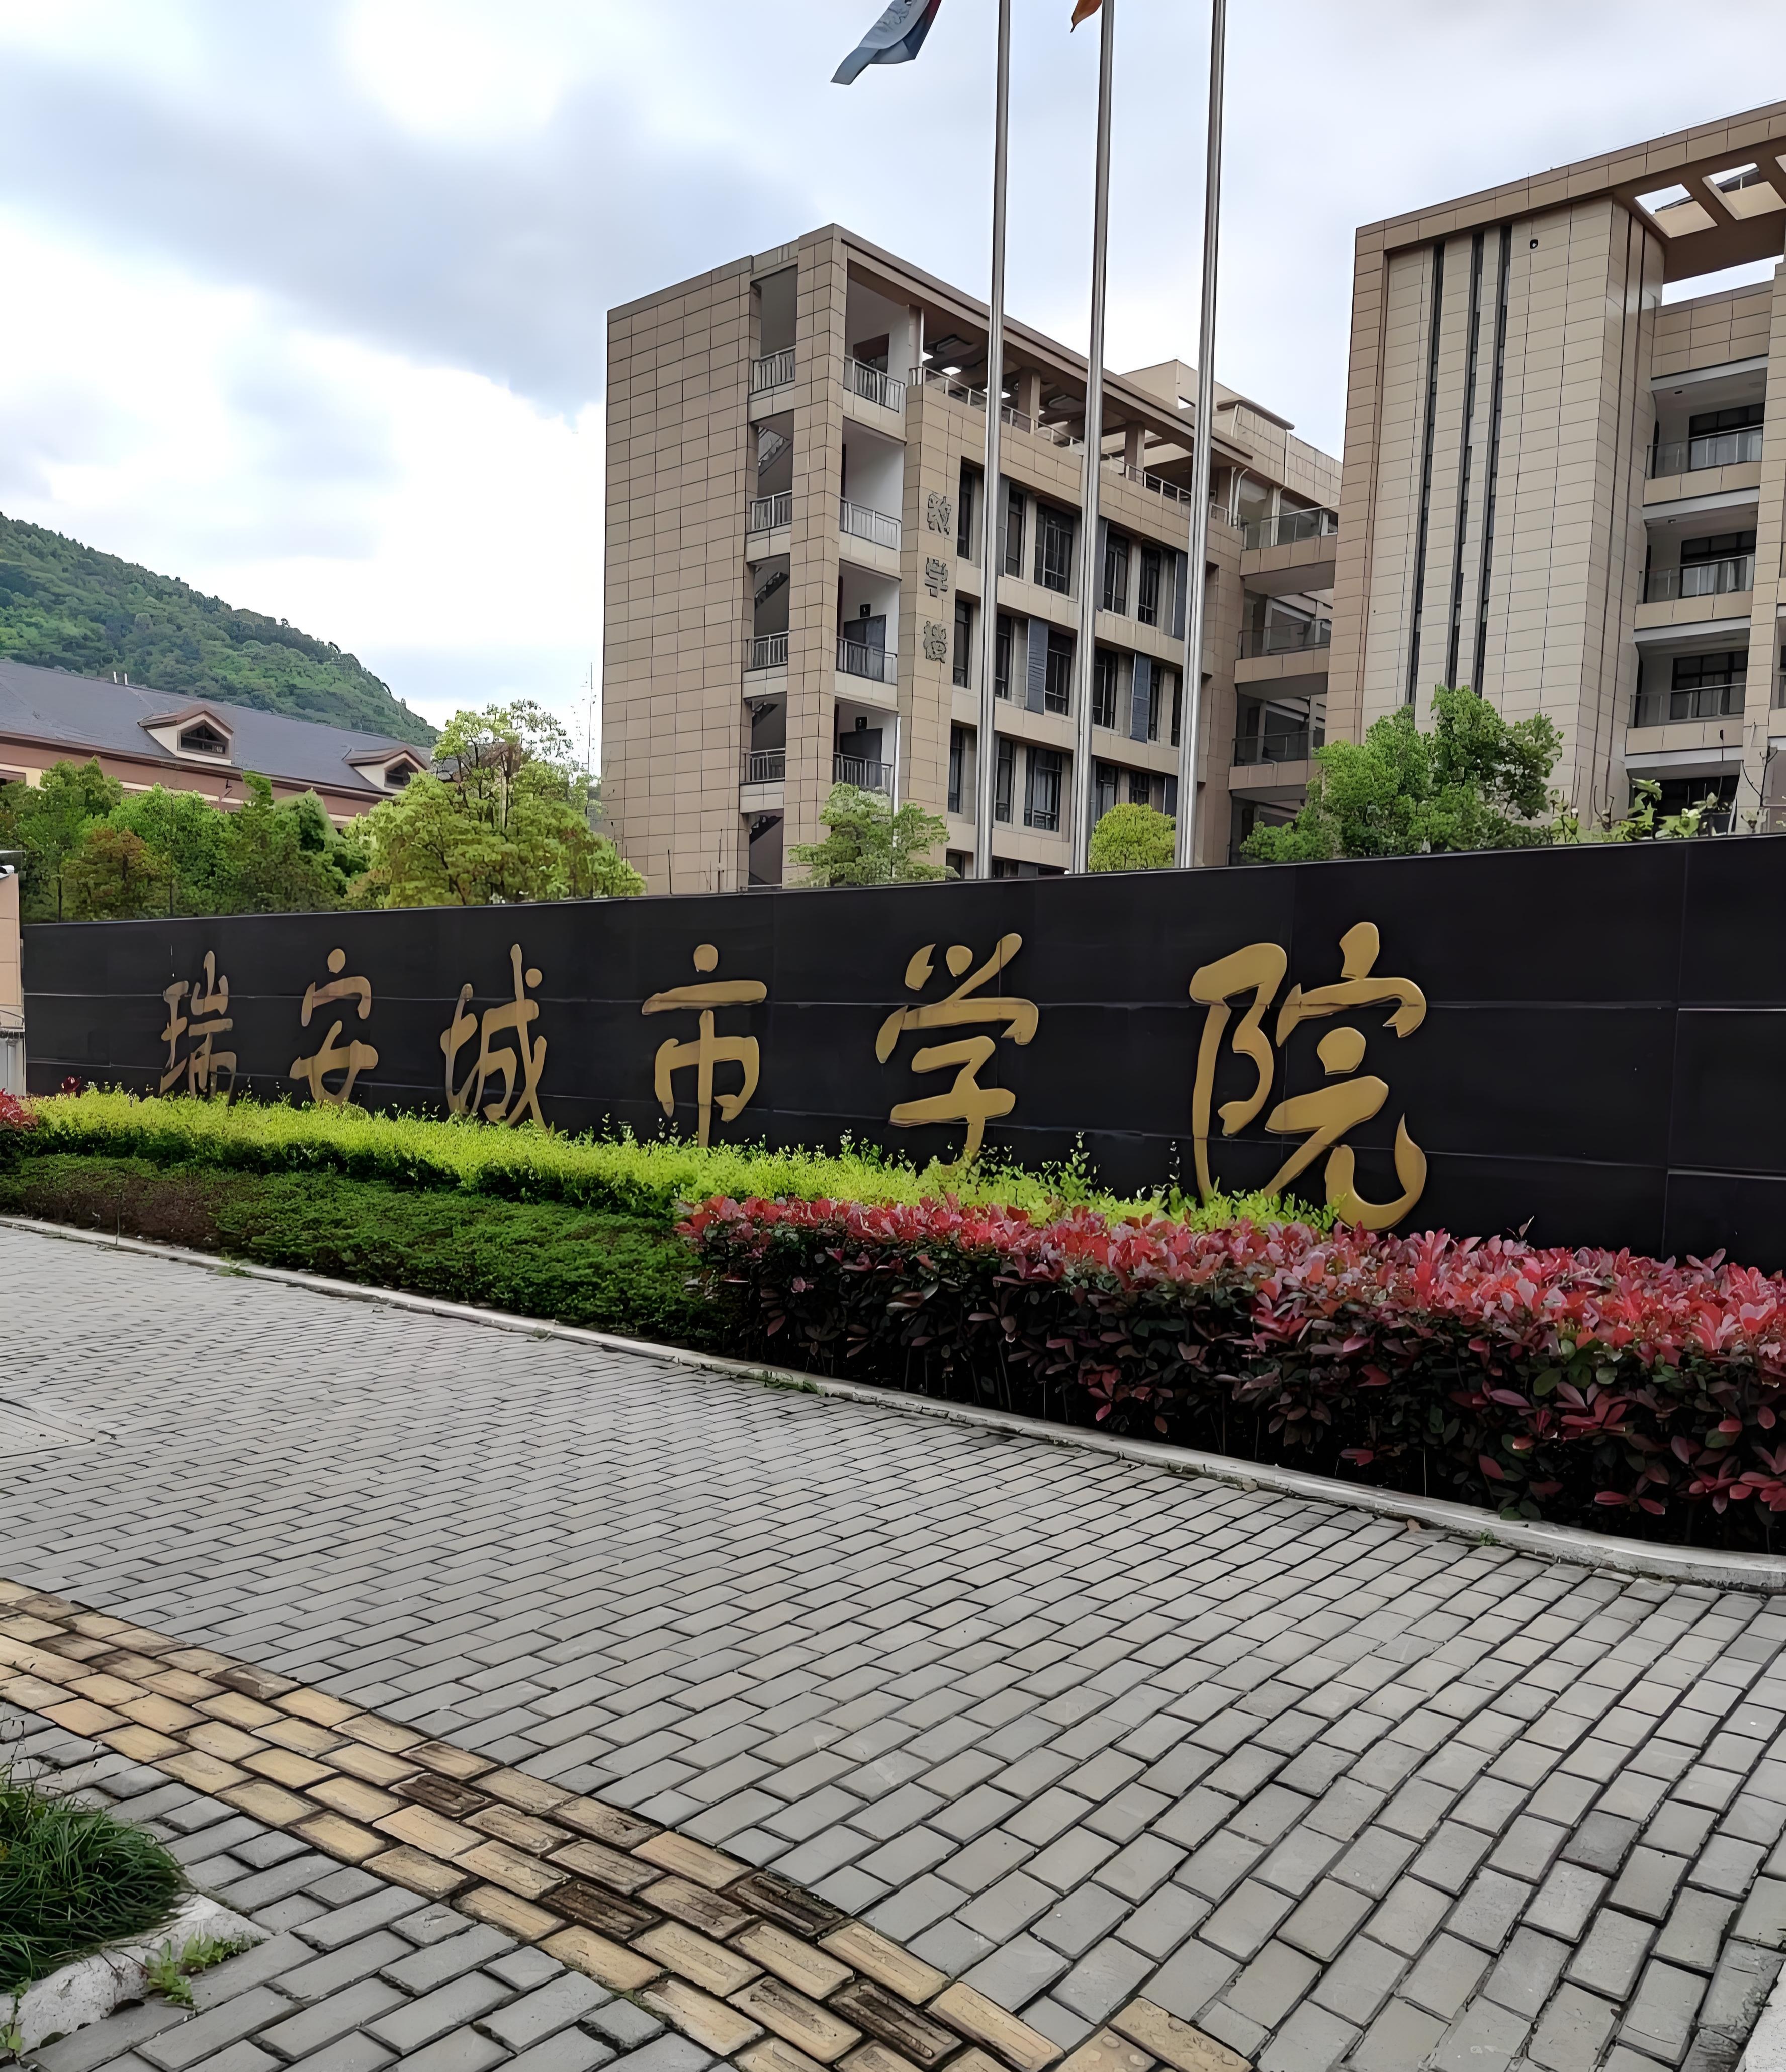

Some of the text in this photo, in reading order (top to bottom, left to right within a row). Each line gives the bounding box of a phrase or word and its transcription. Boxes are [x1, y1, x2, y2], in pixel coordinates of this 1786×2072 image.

[159, 921, 1427, 1230] 瑞安城市学院
